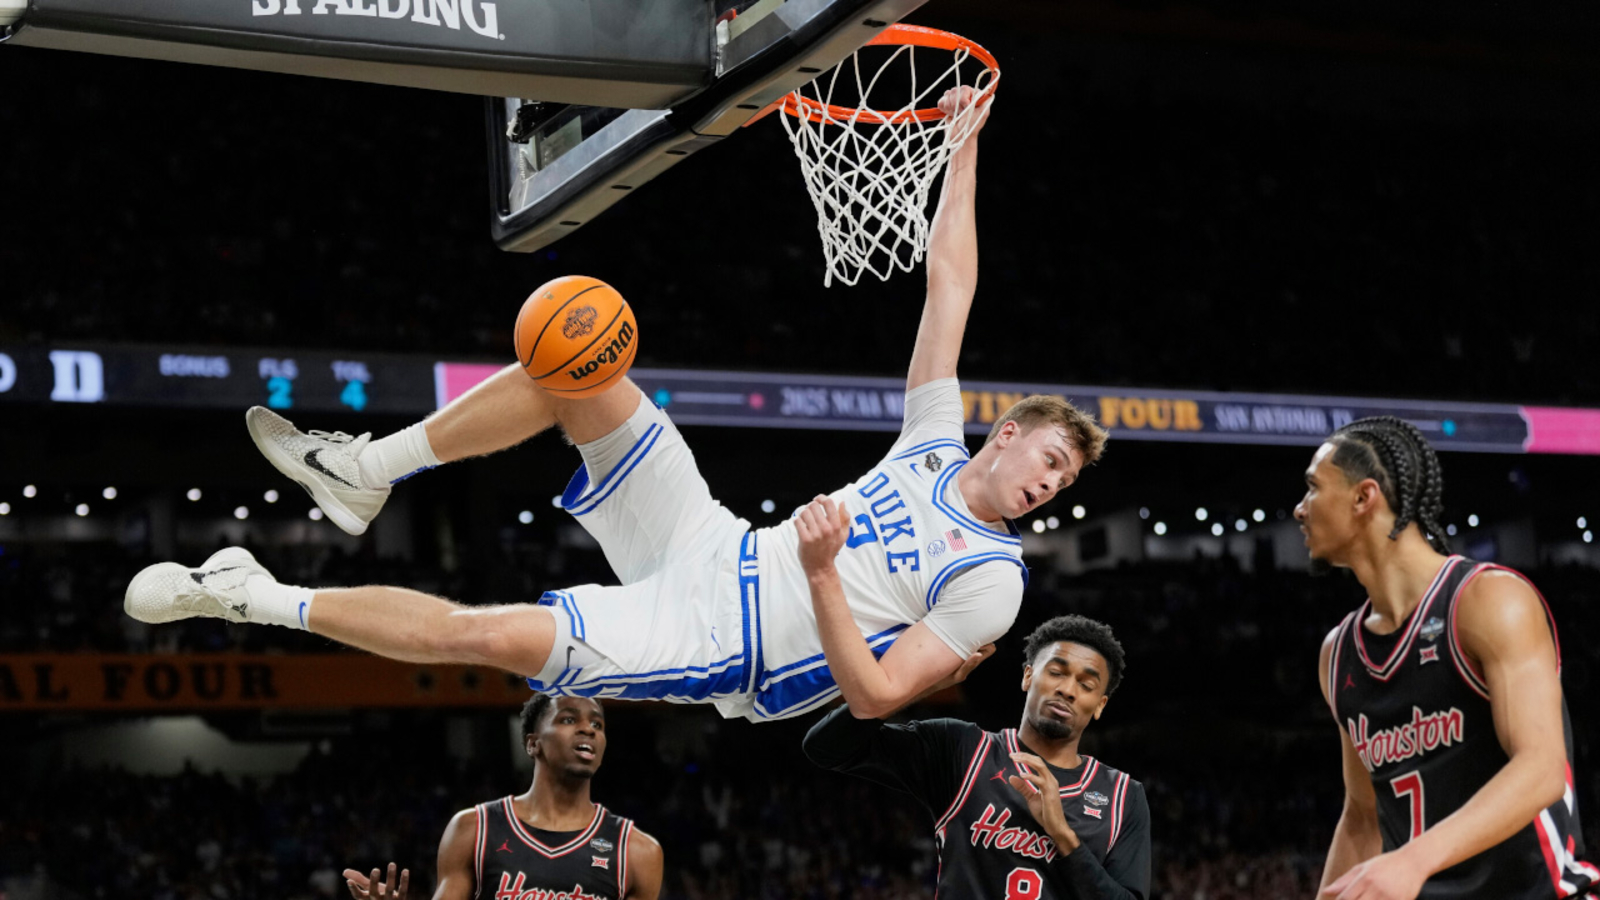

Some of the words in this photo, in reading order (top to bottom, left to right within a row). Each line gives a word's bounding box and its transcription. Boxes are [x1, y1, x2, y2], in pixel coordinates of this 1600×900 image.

[568, 320, 634, 380] Wilson
[267, 376, 293, 409] 2
[339, 379, 368, 411] 4
[1098, 396, 1203, 430] FOUR
[857, 472, 920, 574] DUKE
[101, 662, 279, 700] FOUR
[1347, 705, 1464, 773] Houston
[970, 803, 1057, 863] Hous
[1389, 770, 1425, 843] 7
[495, 870, 607, 900] Houst
